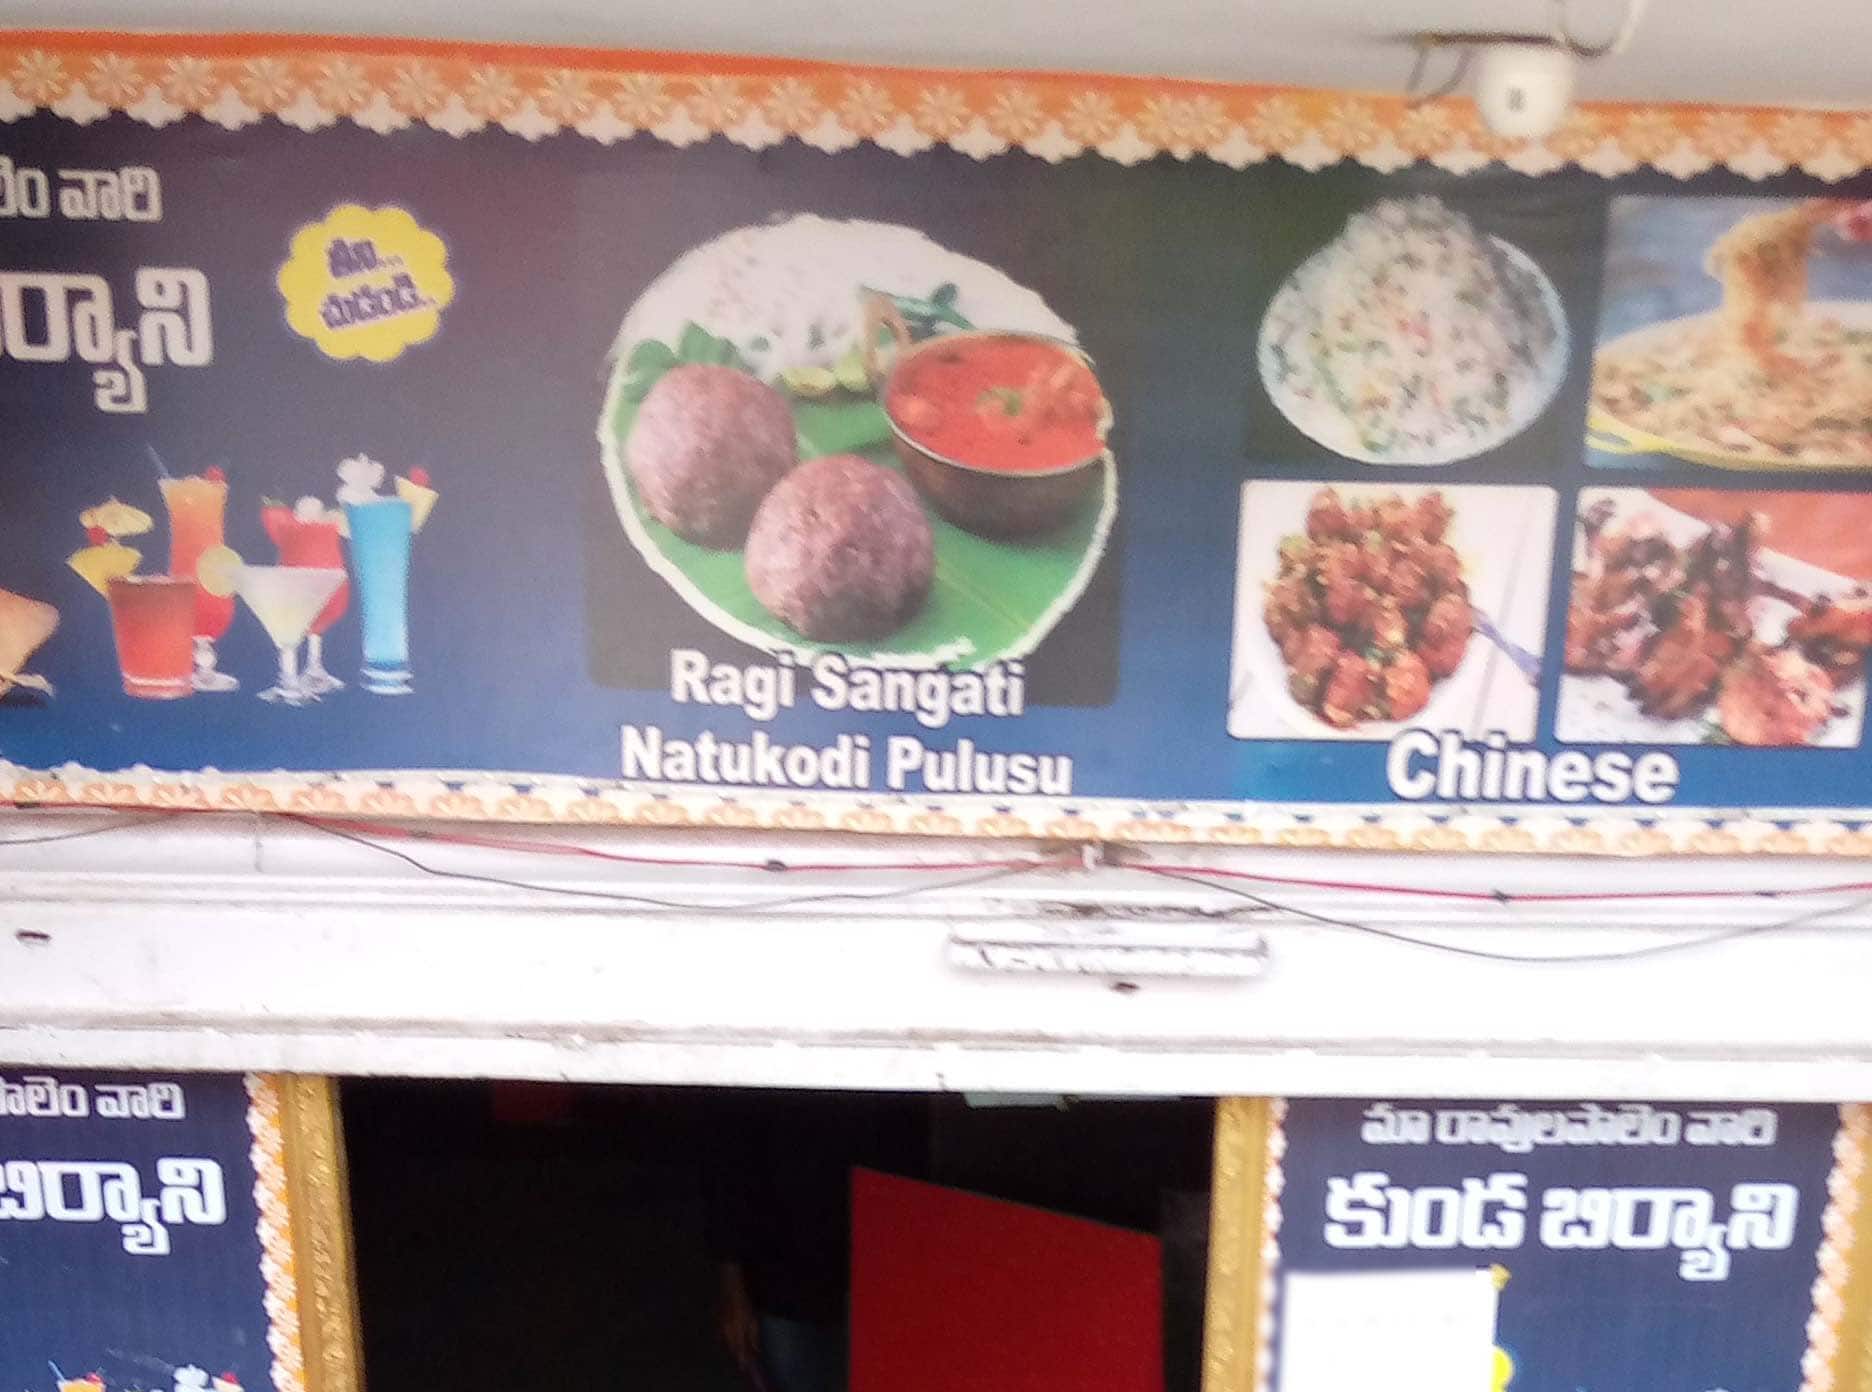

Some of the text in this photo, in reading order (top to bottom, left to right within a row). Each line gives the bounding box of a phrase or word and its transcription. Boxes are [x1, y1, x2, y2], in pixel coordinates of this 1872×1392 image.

[58, 166, 163, 222] వారి
[670, 649, 1026, 728] Ragi Sangati
[620, 724, 1073, 795] Natukodi Pulusu
[1386, 728, 1680, 804] Chinese
[95, 1082, 186, 1119] వారి
[1685, 1109, 1778, 1145] వారి
[1324, 1171, 1799, 1282] కుండ బిర్యాని
